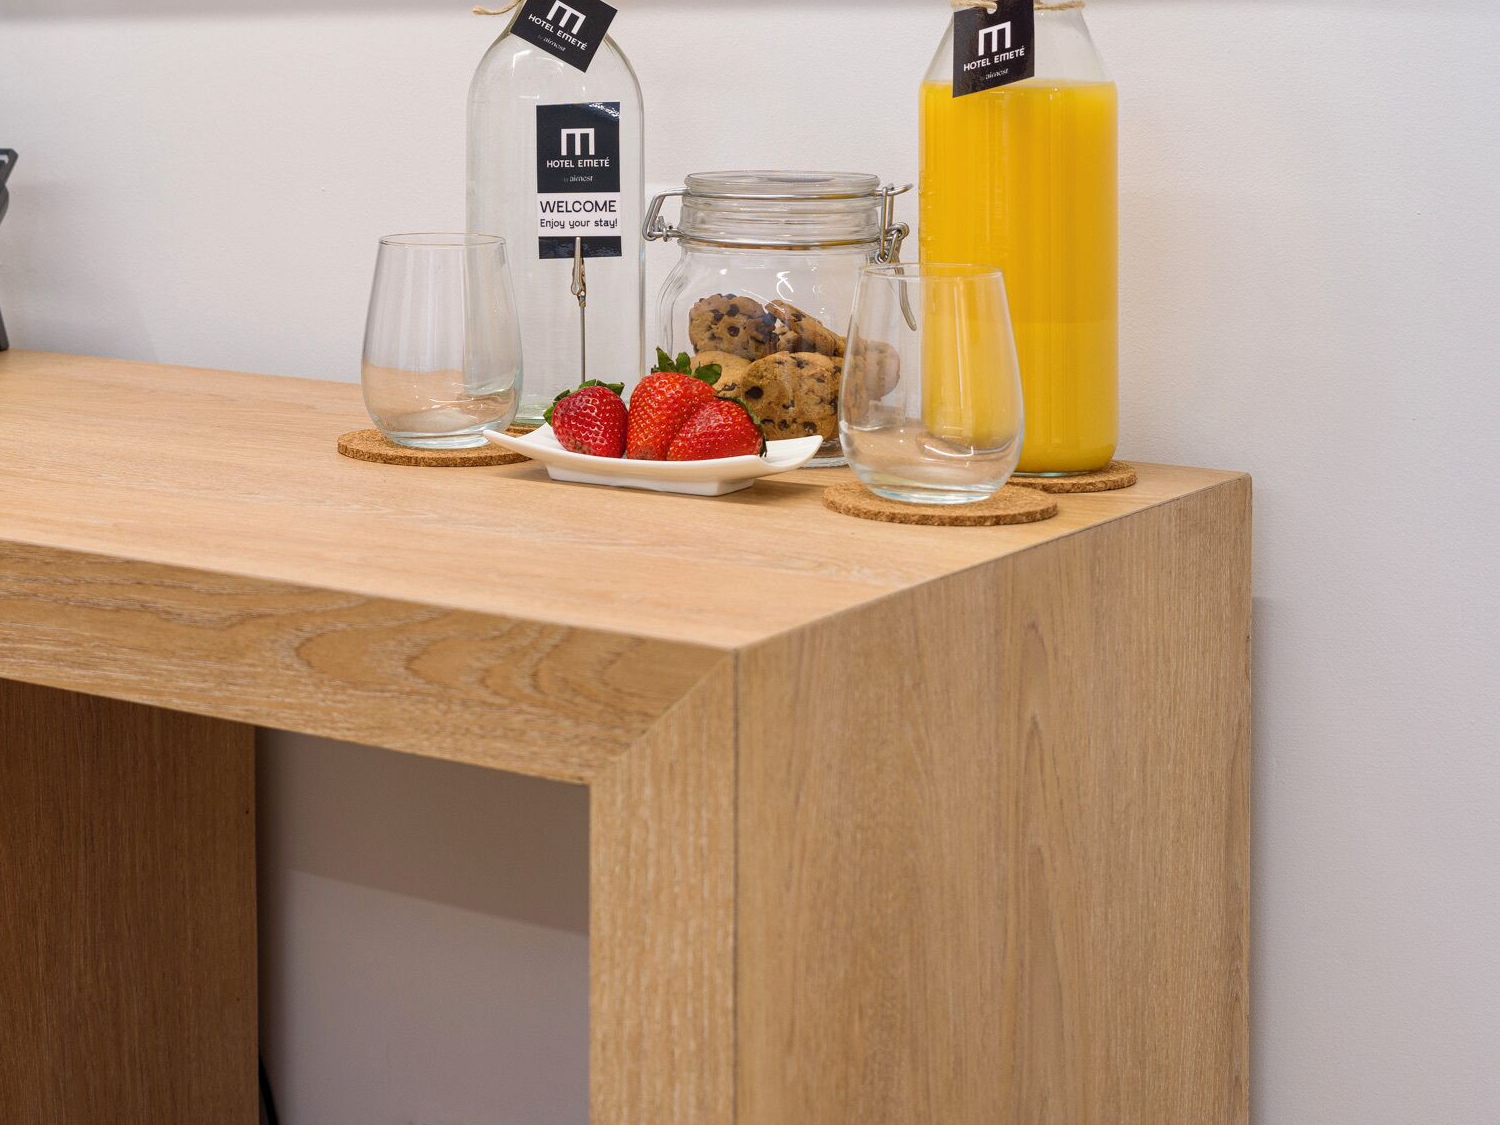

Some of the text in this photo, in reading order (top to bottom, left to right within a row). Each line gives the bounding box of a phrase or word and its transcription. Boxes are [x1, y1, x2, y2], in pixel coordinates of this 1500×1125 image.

[528, 13, 588, 51] HOTEL EMETÉ
[963, 45, 1025, 72] HOTEL EMETÉ
[546, 156, 610, 168] HOTEL EMETÉ
[539, 199, 617, 214] WELCOME
[540, 217, 618, 229] Enjoy your stay!
